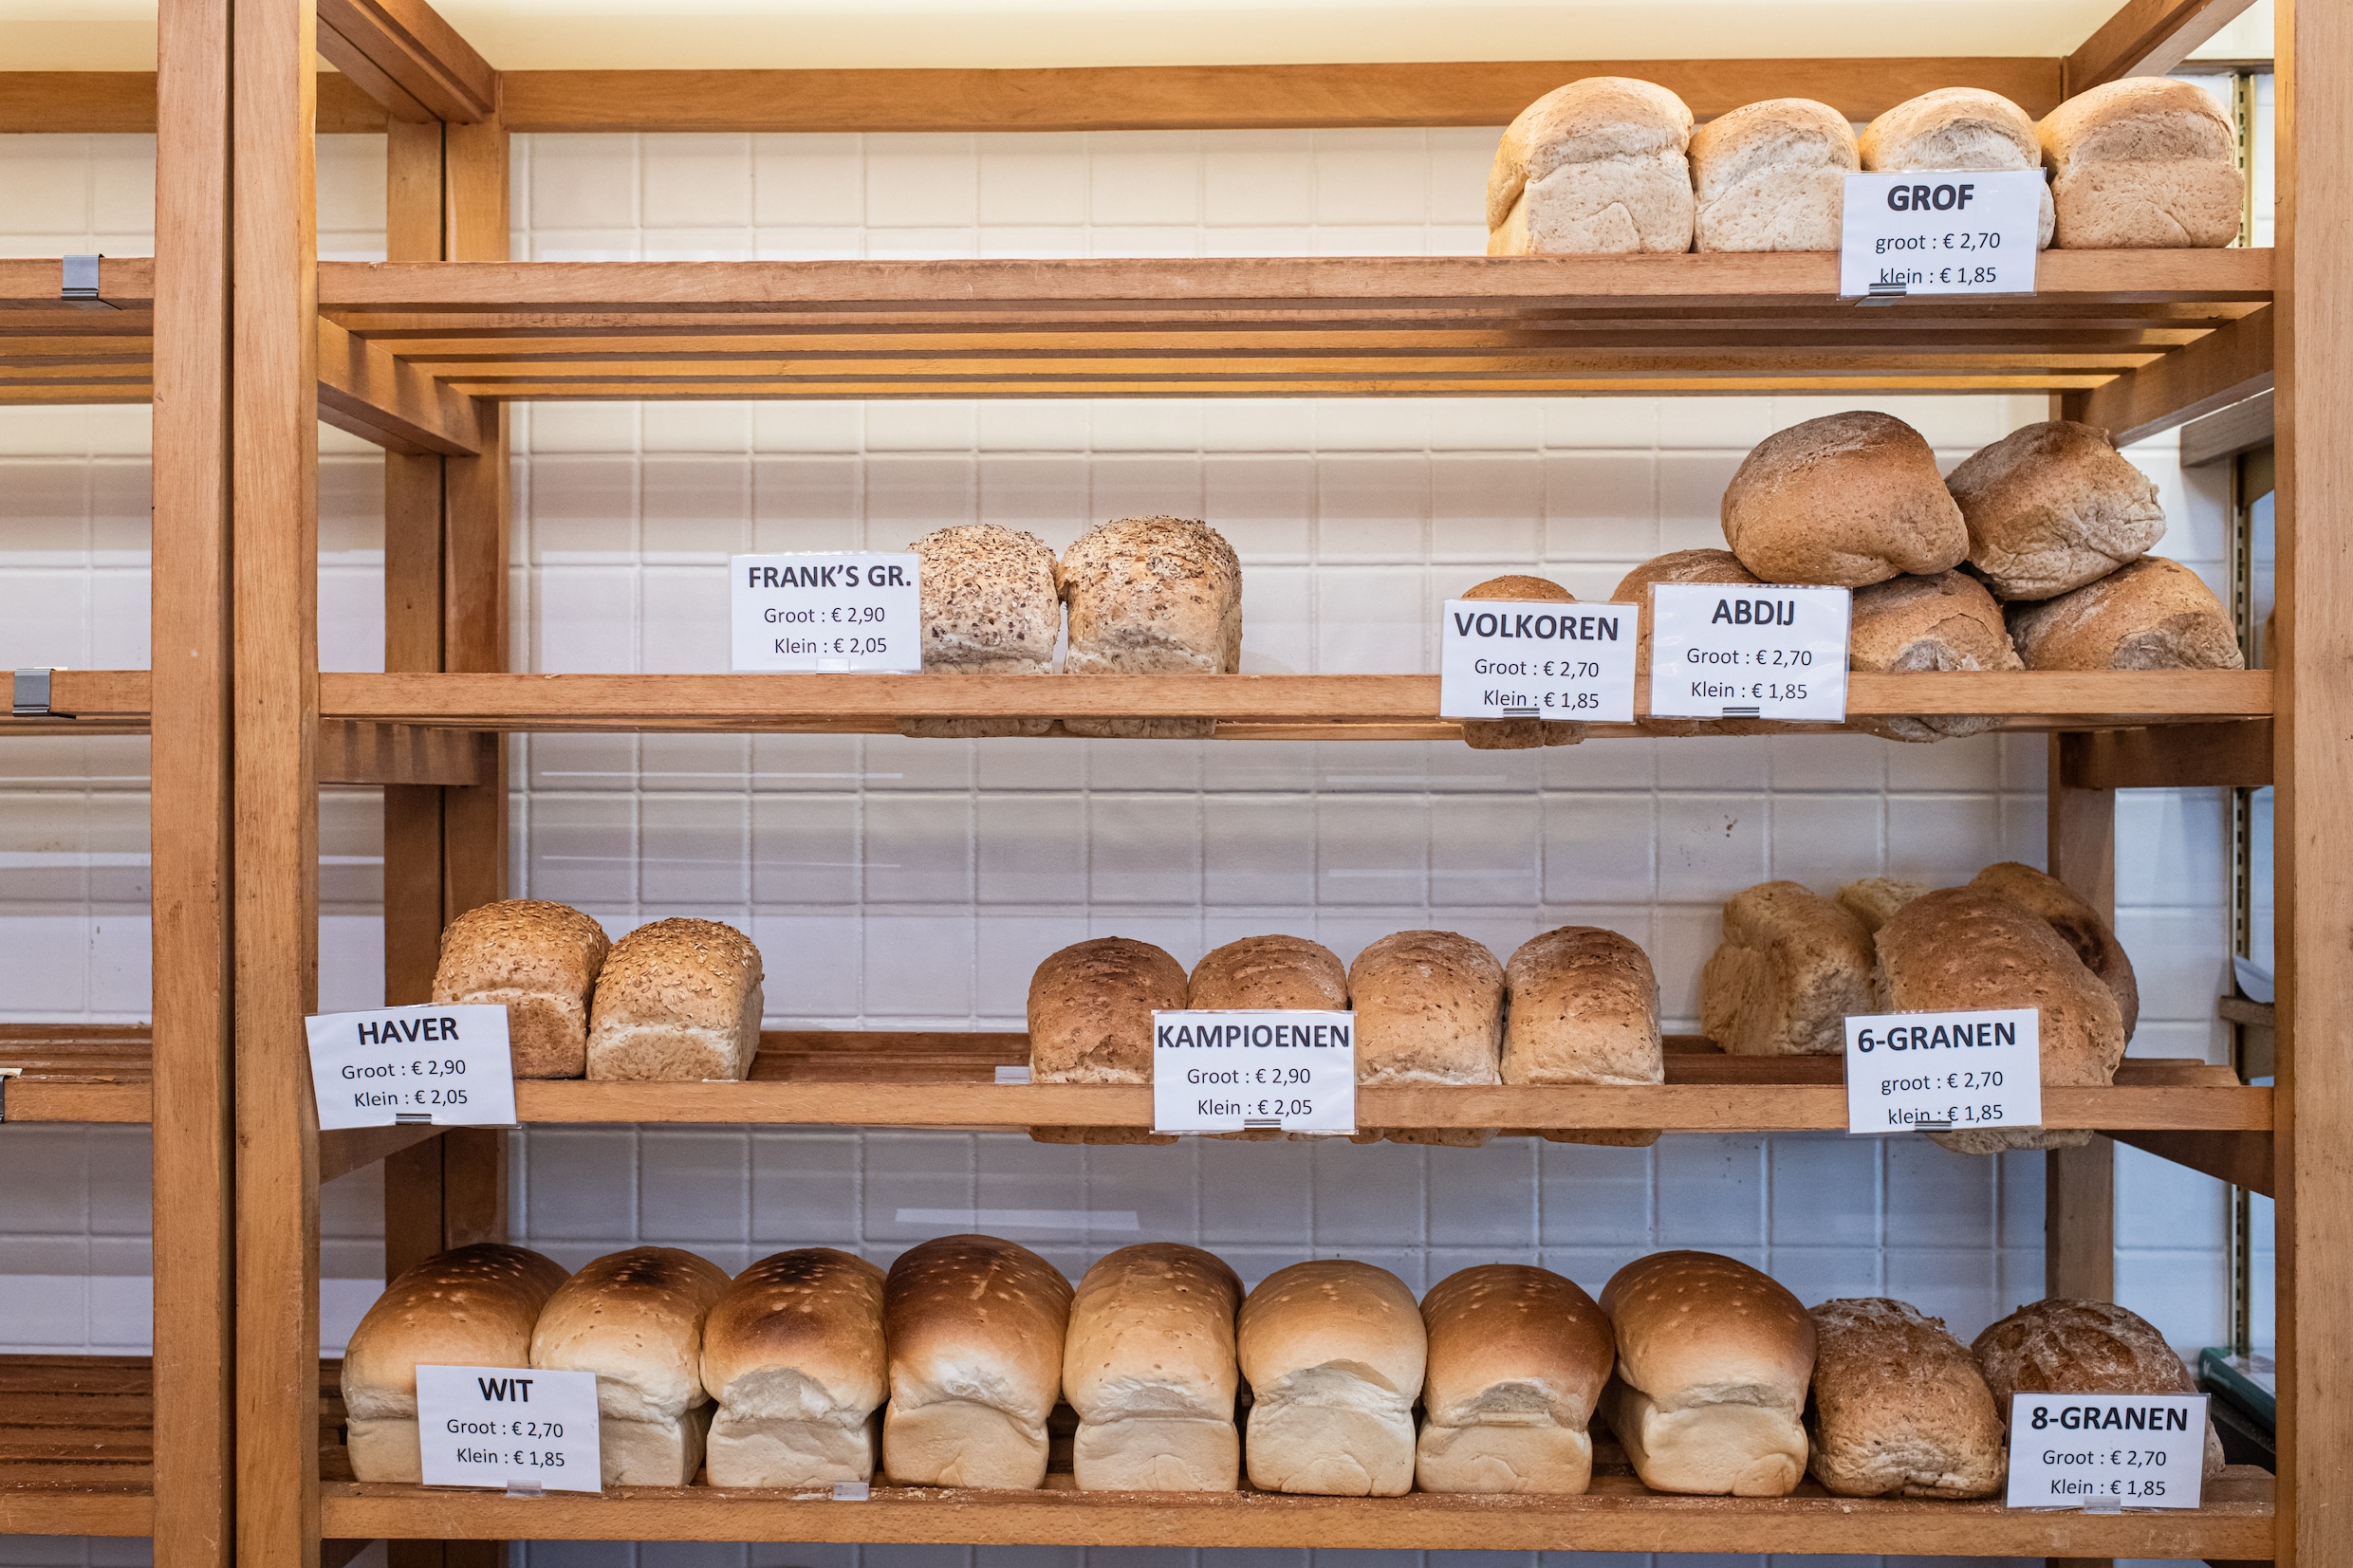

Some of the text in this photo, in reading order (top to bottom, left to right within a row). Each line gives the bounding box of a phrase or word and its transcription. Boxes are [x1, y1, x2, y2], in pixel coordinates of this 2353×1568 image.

[1887, 184, 1974, 212] GROF
[1876, 232, 2000, 254] groot : € 2,70
[1880, 267, 1996, 286] klein : € 1,85
[750, 564, 911, 588] FRANK’S GR.
[765, 607, 884, 625] Groot : € 2,90
[1712, 600, 1794, 626] ABDIJ
[1454, 613, 1618, 641] VOLKOREN
[775, 638, 886, 655] Klein : € 2,05
[1687, 648, 1811, 668] Groot : € 2,70
[1475, 659, 1599, 679] Groot : € 2,70
[1485, 690, 1599, 710] Klein : € 1,85
[1692, 681, 1806, 701] Klein : € 1,85
[358, 1017, 459, 1045] HAVER
[1158, 1025, 1349, 1047] KAMPIOENEN
[1859, 1023, 2015, 1053] 6-GRANEN
[342, 1060, 465, 1079] Groot : € 2,90
[1188, 1068, 1310, 1086] Groot : € 2,90
[1881, 1071, 2003, 1095] groot : € 2,70
[355, 1090, 467, 1107] Klein : € 2,05
[1198, 1099, 1312, 1118] Klein : € 2,05
[1889, 1108, 1932, 1126] klein
[1947, 1107, 1958, 1122] €
[1965, 1104, 2003, 1123] 1,85
[478, 1377, 533, 1402] WIT
[447, 1419, 563, 1439] Groot : € 2,70
[2031, 1407, 2187, 1431] 8-GRANEN
[457, 1448, 565, 1467] Klein : € 1,85
[2043, 1450, 2166, 1467] Groot : € 2,70
[2051, 1479, 2165, 1498] Klein : € 1,85
